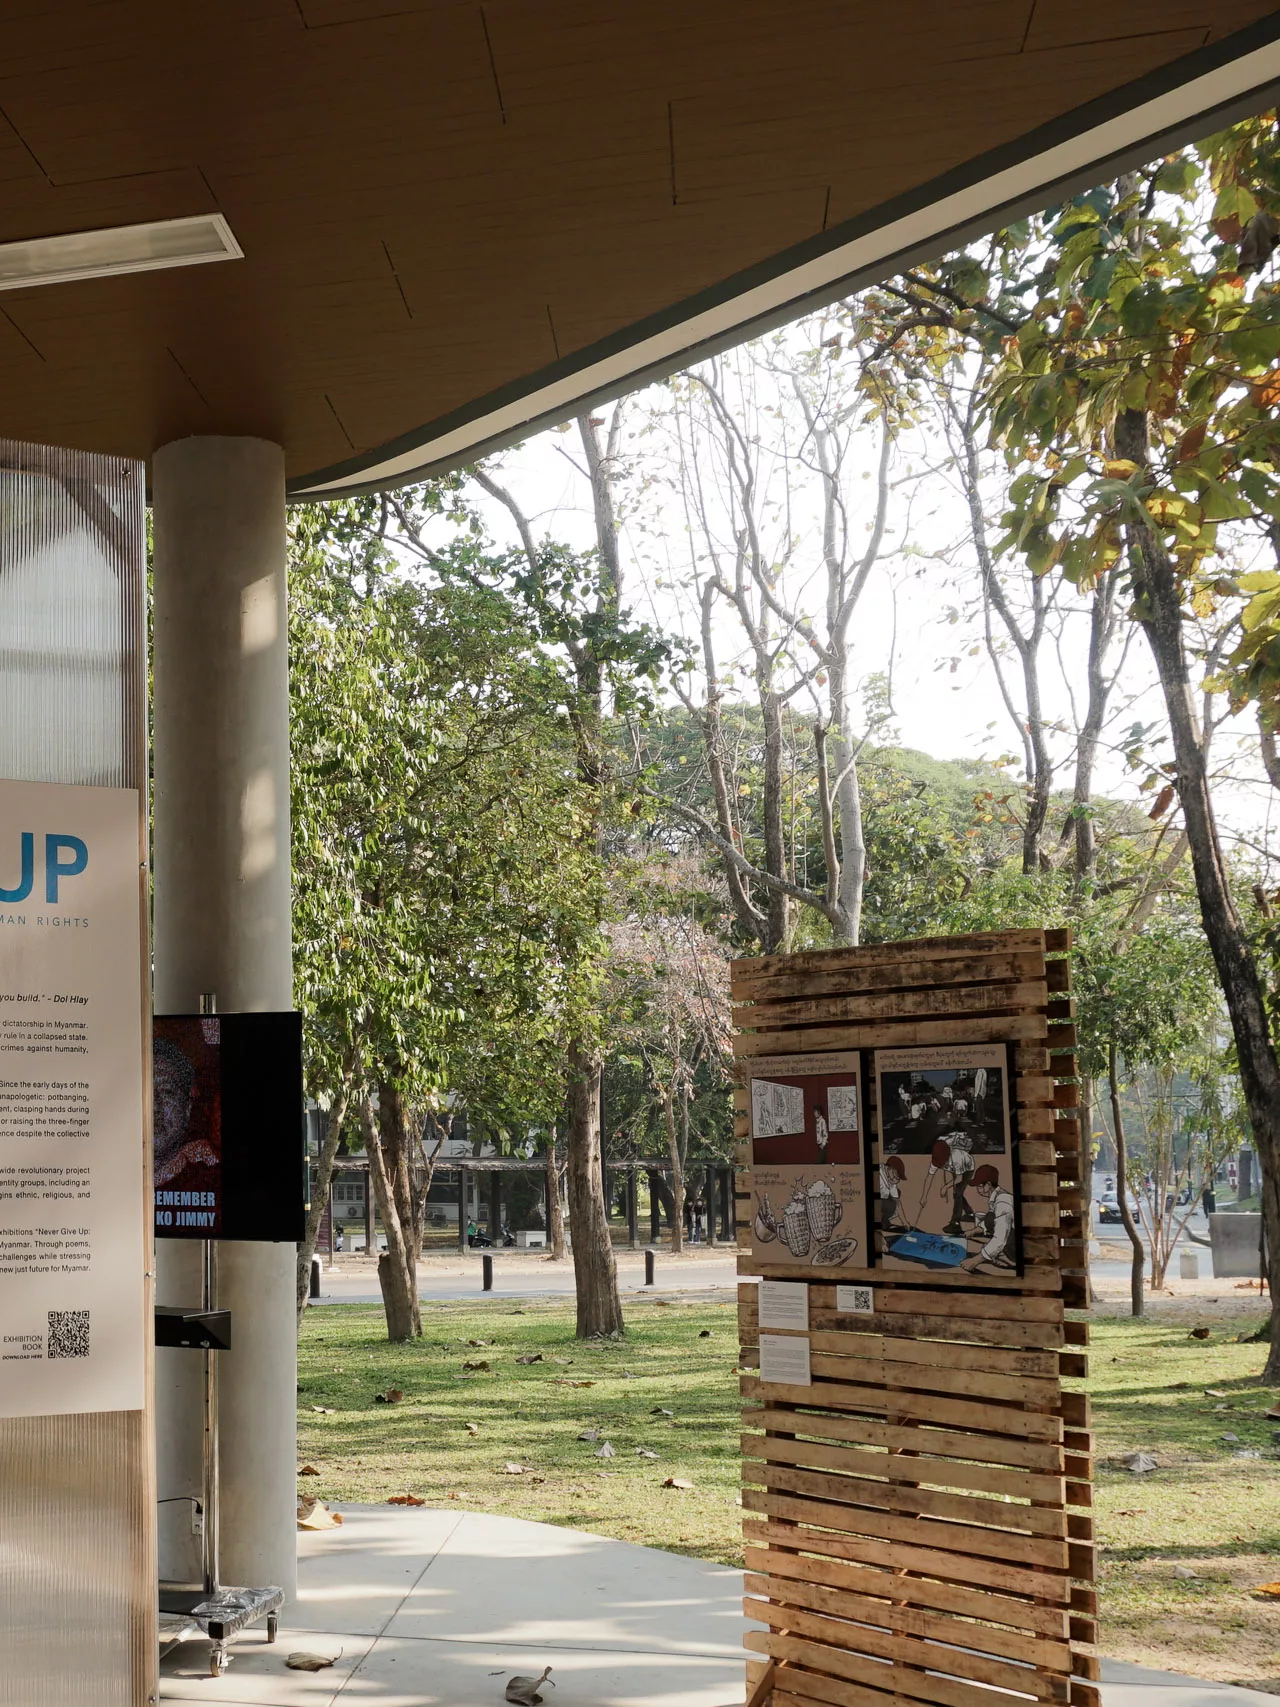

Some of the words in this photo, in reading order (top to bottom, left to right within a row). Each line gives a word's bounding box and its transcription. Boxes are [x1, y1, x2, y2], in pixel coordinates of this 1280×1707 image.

[37, 916, 89, 927] RIGHTS
[0, 994, 15, 1003] you
[2, 1019, 44, 1029] dictatorship
[54, 1020, 88, 1030] Myanmar.
[19, 1031, 25, 1039] in
[33, 1032, 67, 1042] collapsed
[69, 1032, 87, 1040] state.
[33, 1080, 50, 1090] early
[51, 1080, 68, 1090] days
[16, 1190, 39, 1199] ethnic,
[43, 1190, 74, 1200] religious,
[154, 1191, 215, 1206] EMEMBER
[156, 1211, 172, 1226] KO
[176, 1212, 216, 1226] JIMMY
[35, 1239, 63, 1249] Through
